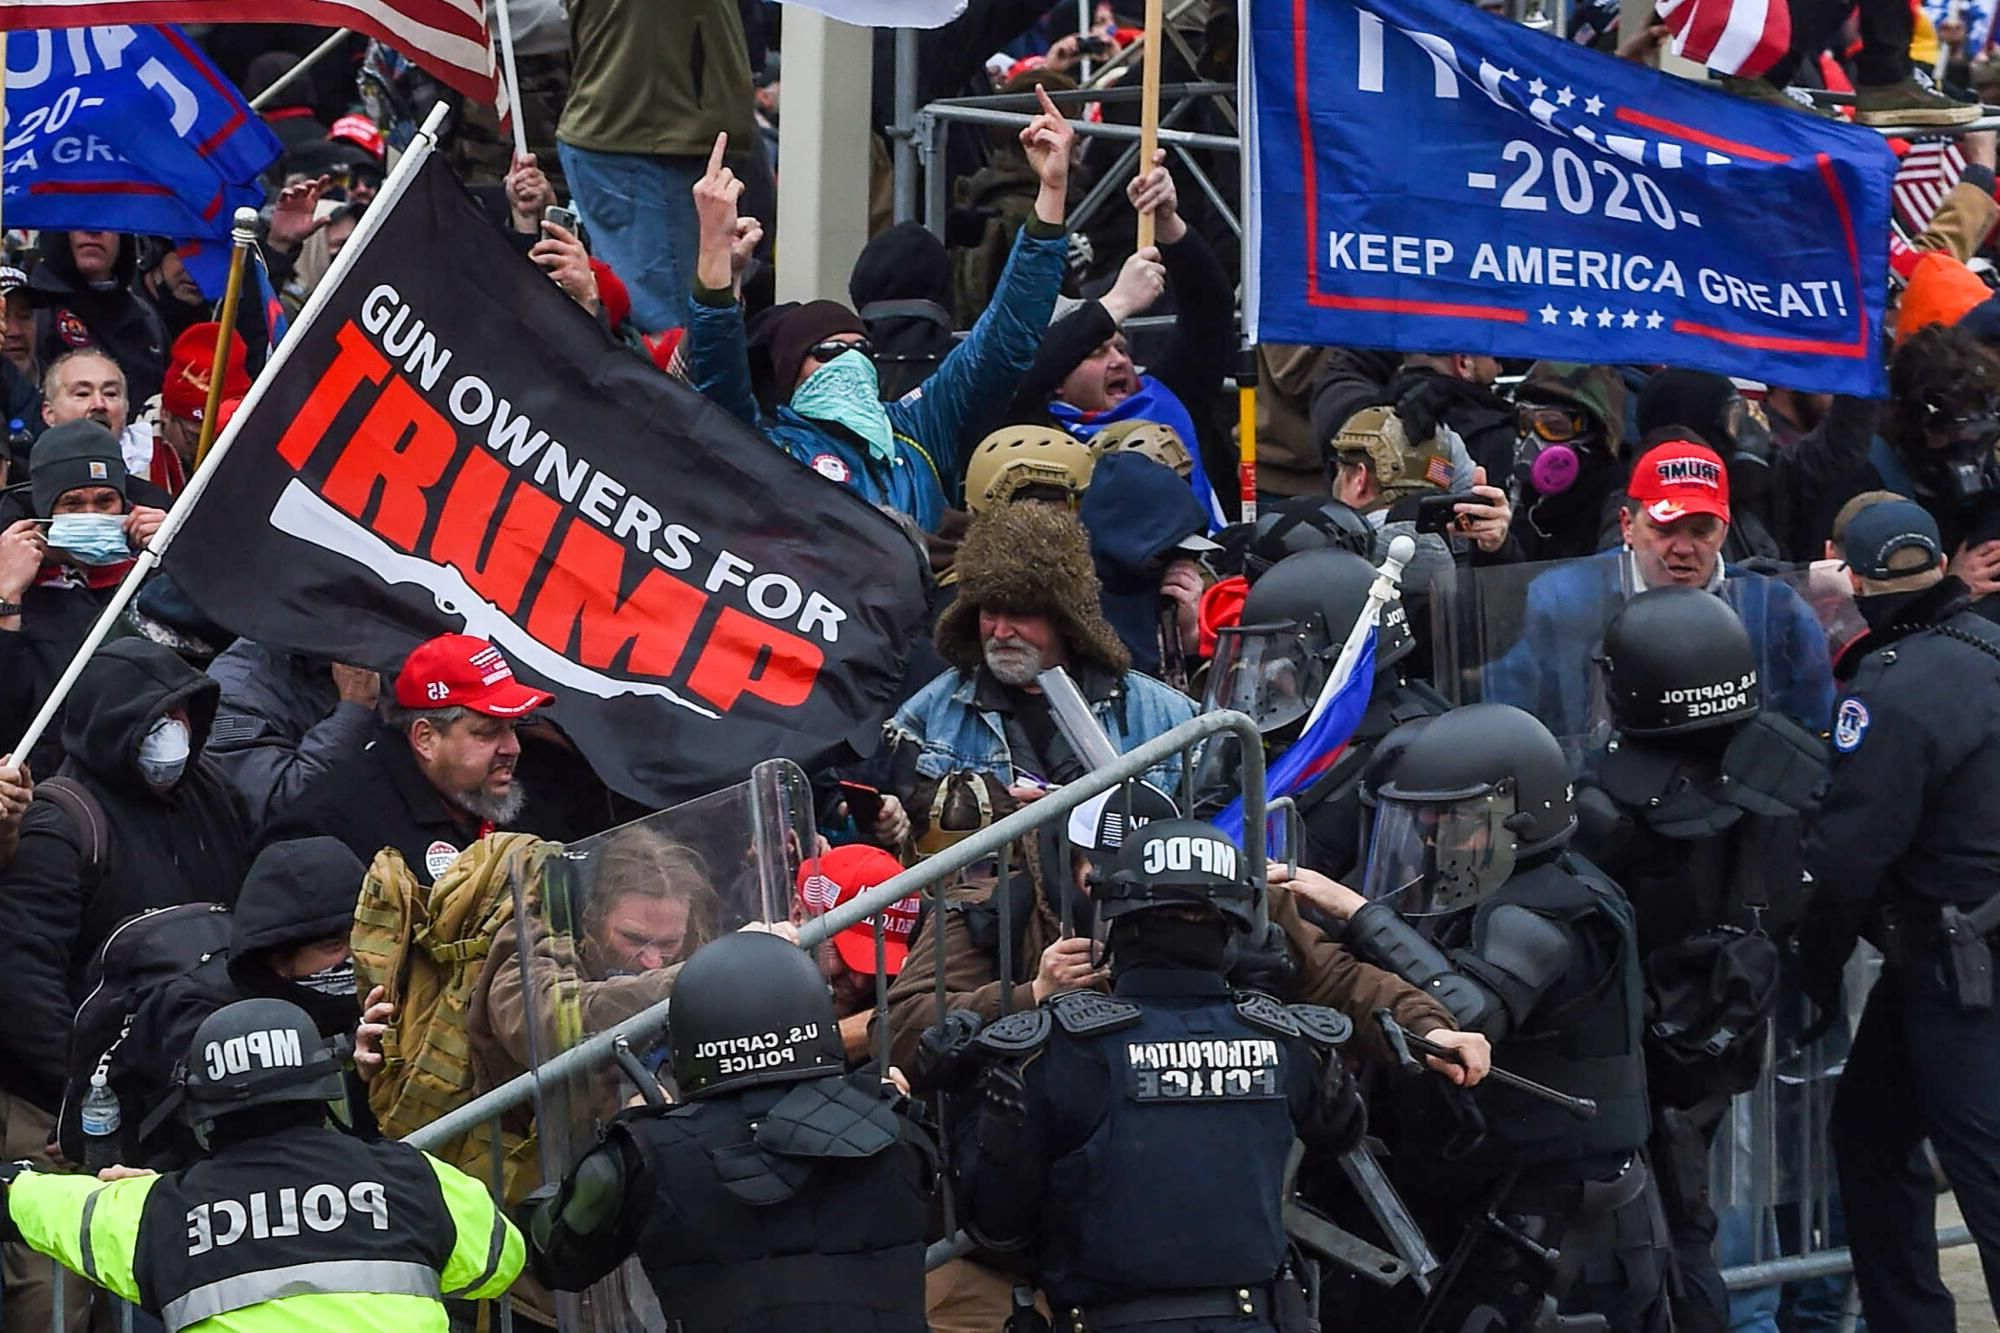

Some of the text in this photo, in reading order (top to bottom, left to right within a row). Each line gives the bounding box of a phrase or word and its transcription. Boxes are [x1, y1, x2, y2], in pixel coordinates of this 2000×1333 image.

[1329, 230, 1848, 318] KEEP AMERICA GREAT!
[1468, 140, 1701, 231] -2020-
[276, 319, 825, 712] TRUMP
[361, 284, 847, 643] GUN OWNERS FOR
